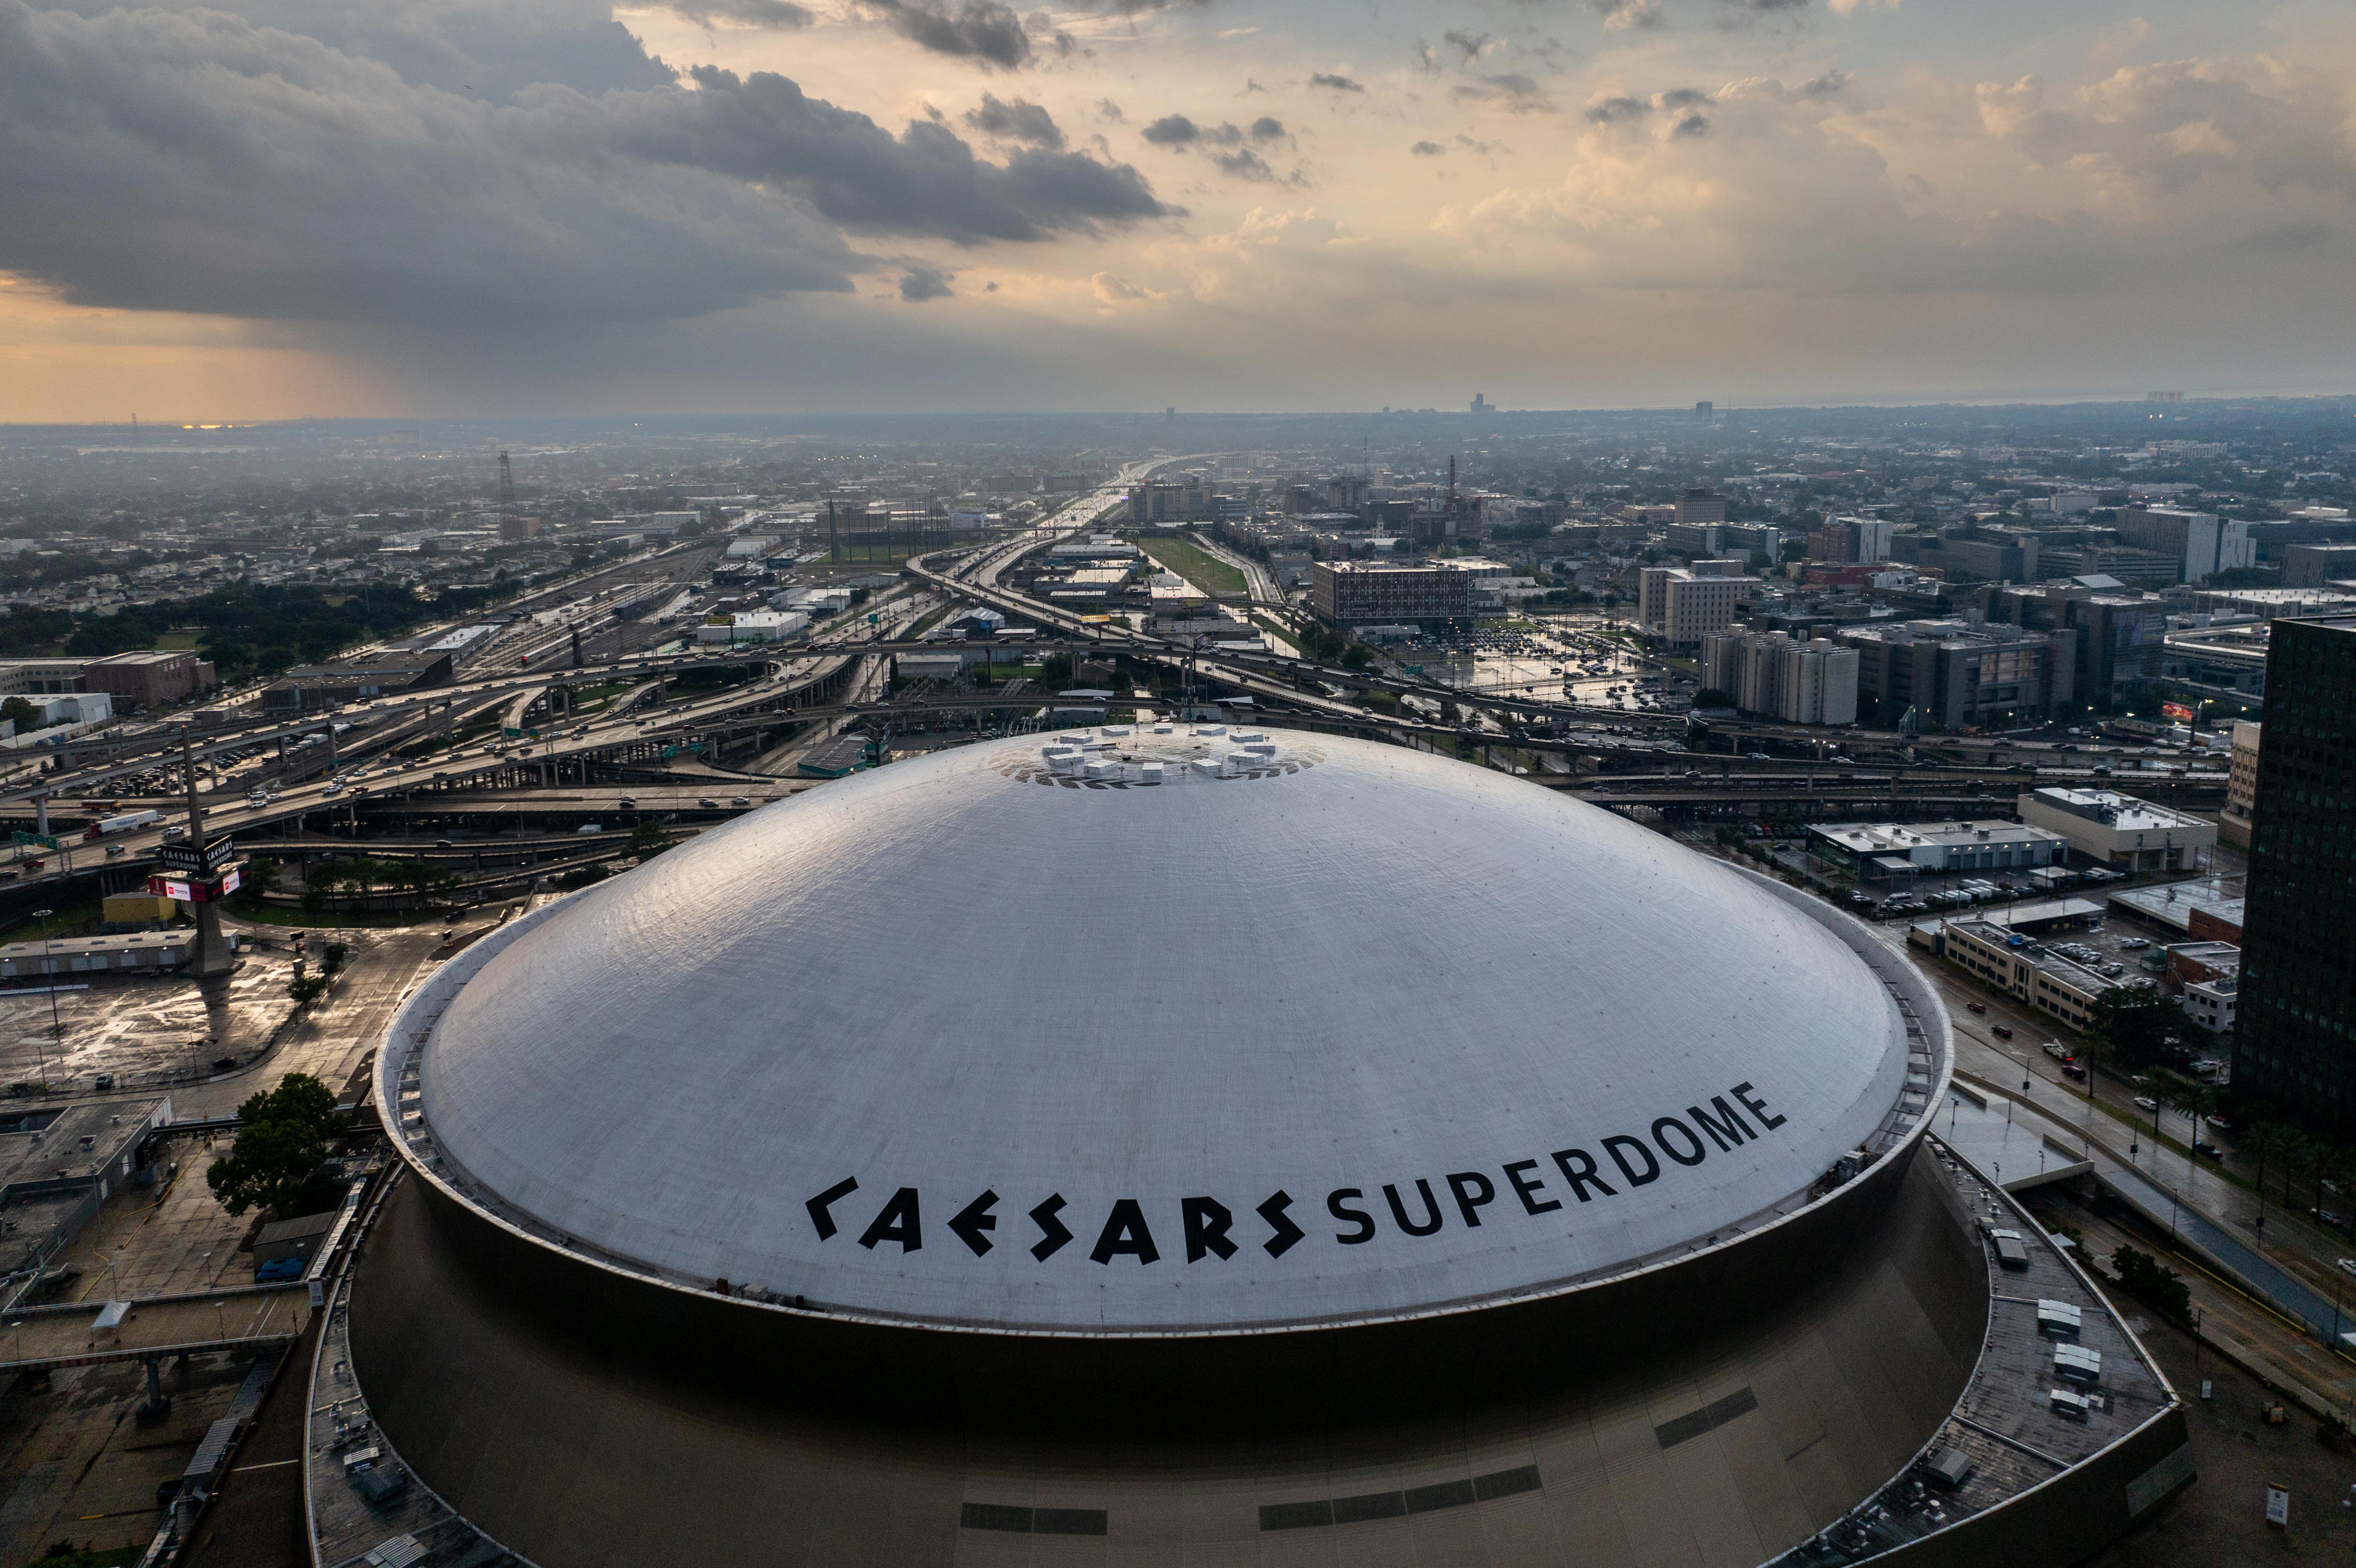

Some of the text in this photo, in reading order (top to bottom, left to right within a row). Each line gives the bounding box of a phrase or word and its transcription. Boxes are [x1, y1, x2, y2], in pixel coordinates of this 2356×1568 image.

[116, 818, 137, 827] Walmart
[162, 851, 201, 862] CAESARS
[206, 841, 232, 861] CAESARS
[165, 861, 200, 871] SUPERDOME
[209, 851, 233, 869] SUPERDOME
[805, 1081, 1787, 1266] CAESARS SUPERDOME
